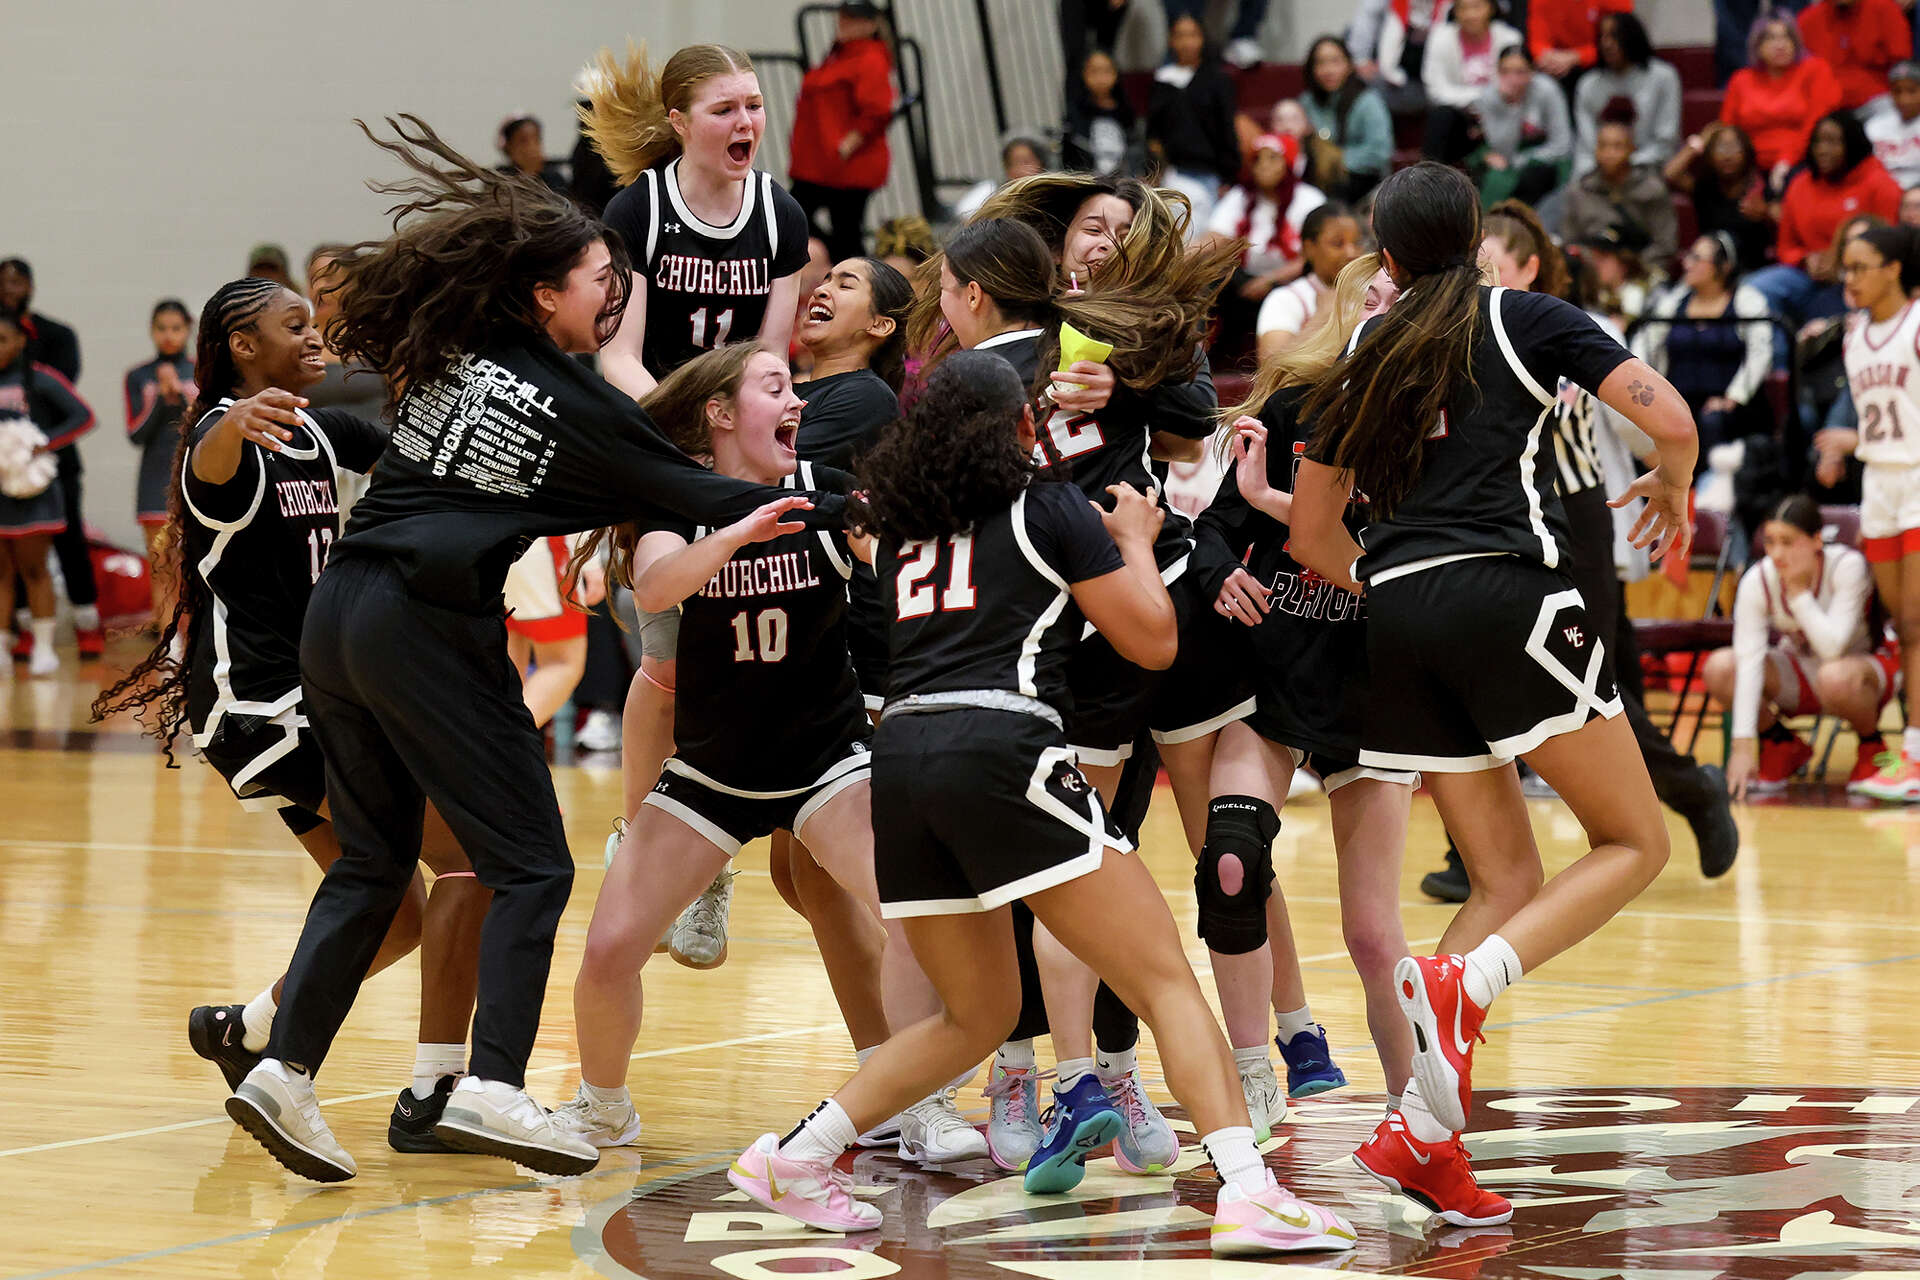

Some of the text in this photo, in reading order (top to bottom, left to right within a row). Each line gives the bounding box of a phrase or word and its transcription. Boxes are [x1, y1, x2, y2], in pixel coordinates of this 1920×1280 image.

[656, 253, 771, 295] CHURCHILL
[690, 307, 733, 349] 11
[1864, 400, 1904, 442] 21
[698, 549, 820, 598] HURCHILL
[896, 534, 977, 622] 21
[731, 606, 788, 662] 10
